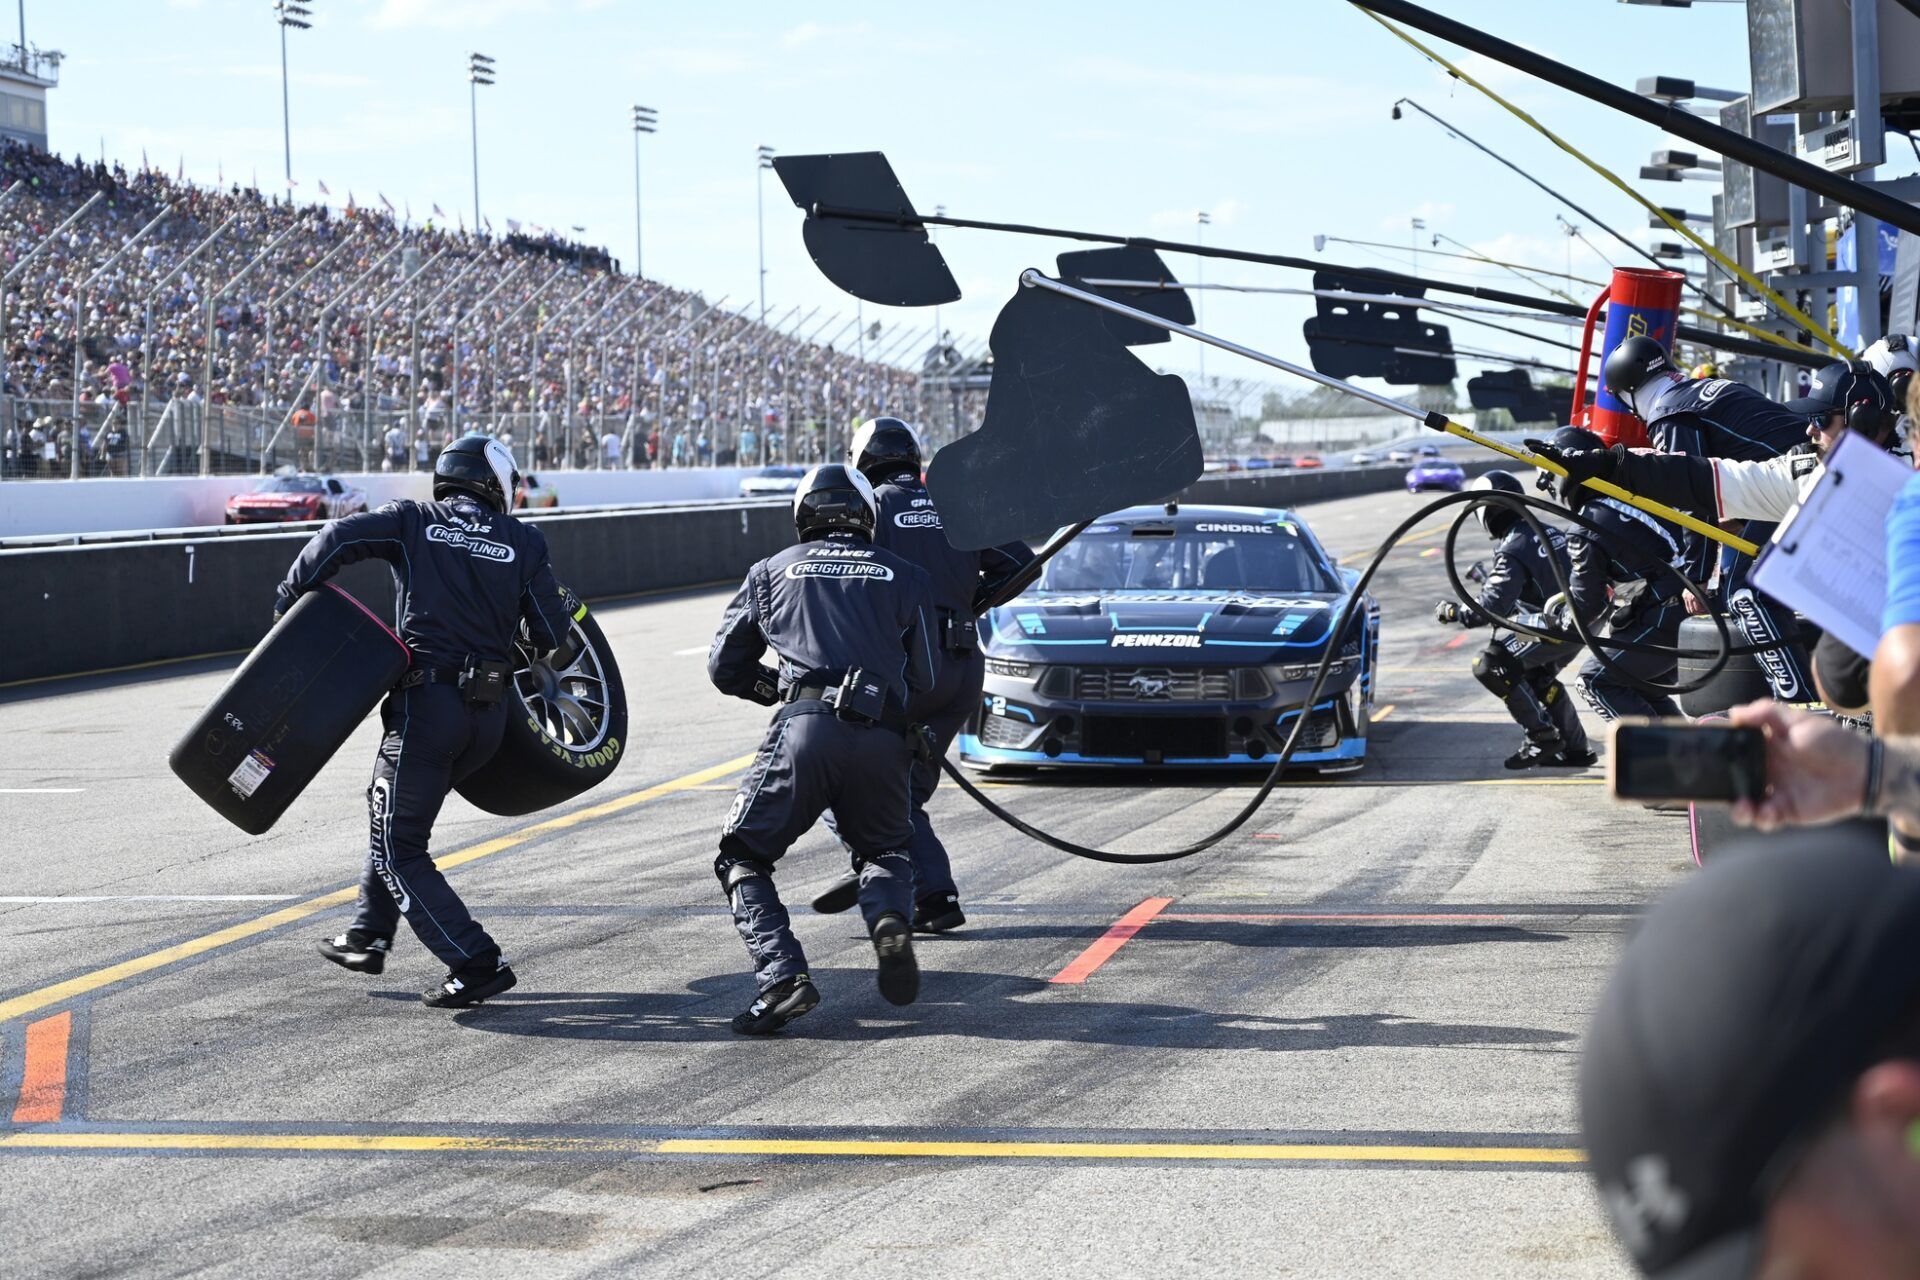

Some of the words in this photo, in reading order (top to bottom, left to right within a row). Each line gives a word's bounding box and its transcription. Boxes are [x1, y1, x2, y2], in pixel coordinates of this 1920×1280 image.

[911, 498, 934, 508] GRA
[1195, 523, 1273, 534] CINDRIC
[433, 528, 507, 558] FREIGTLINER
[806, 547, 876, 558] FRANCE
[795, 562, 885, 577] FREIGHTLINER
[1111, 634, 1202, 648] PENNZOIL
[1737, 599, 1793, 687] FREIGTLINER
[991, 696, 1006, 716] 2
